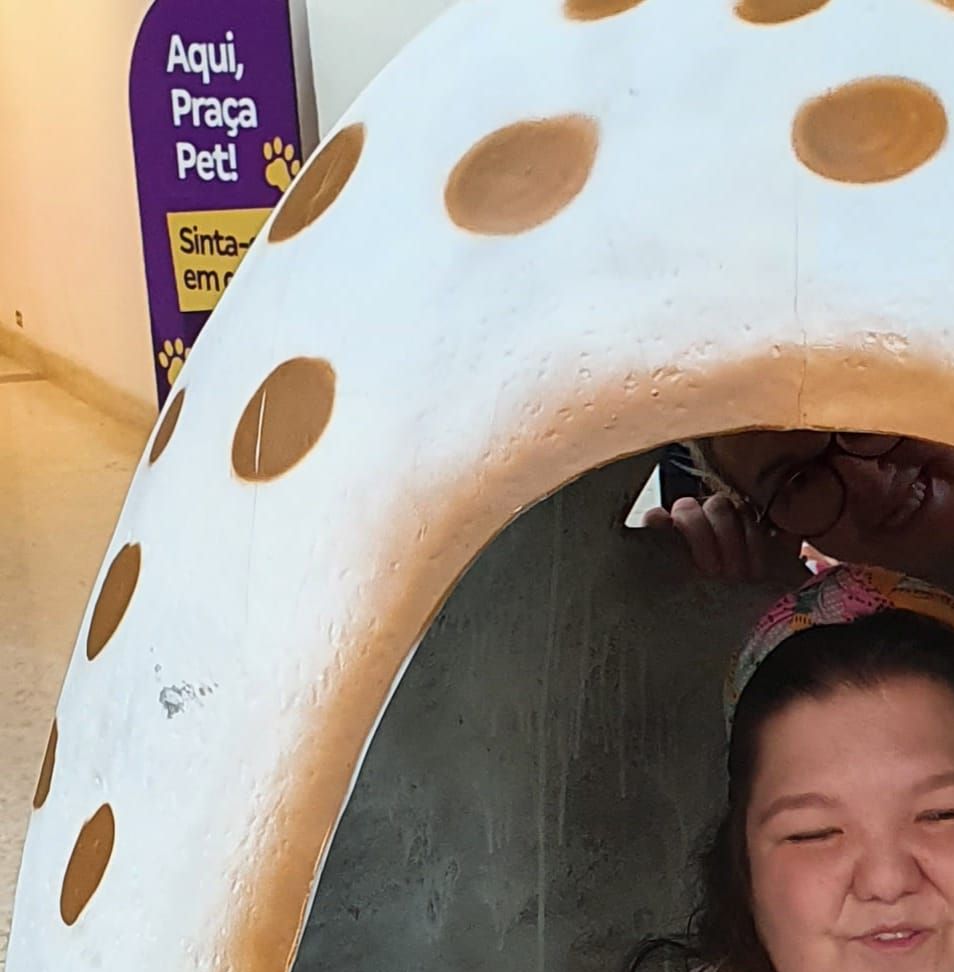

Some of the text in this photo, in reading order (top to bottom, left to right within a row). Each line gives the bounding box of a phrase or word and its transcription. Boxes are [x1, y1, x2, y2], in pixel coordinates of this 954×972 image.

[166, 30, 244, 84] Aqui,
[171, 88, 258, 137] Praça
[176, 142, 239, 182] Pet!
[183, 269, 220, 292] em
